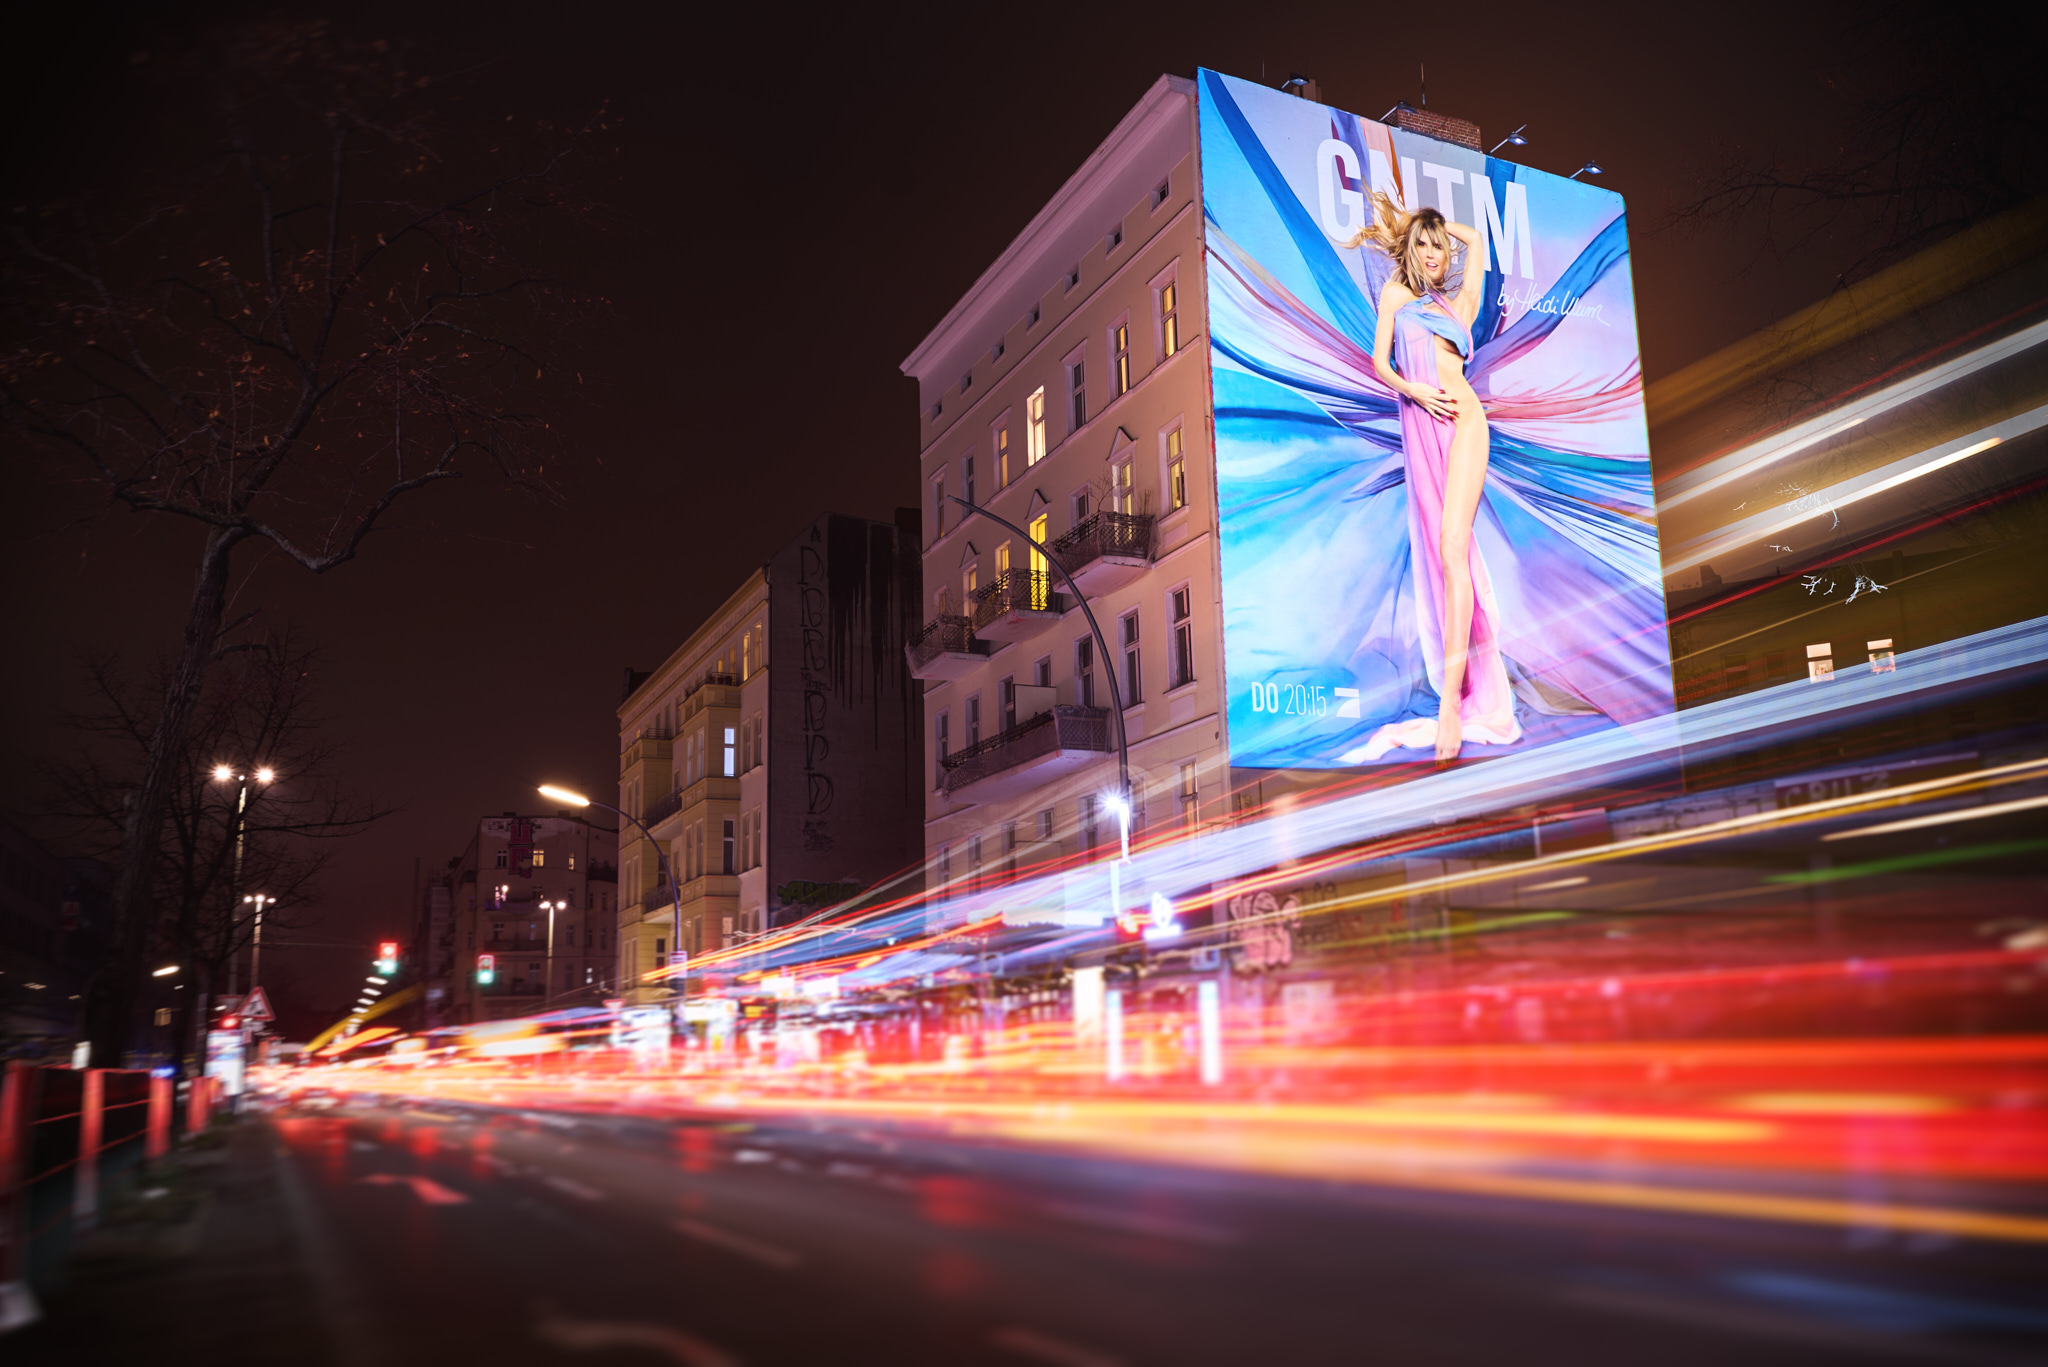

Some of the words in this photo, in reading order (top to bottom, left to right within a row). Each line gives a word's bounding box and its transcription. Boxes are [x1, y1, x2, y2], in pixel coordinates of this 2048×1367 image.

[1316, 138, 1535, 280] GNTM
[1496, 283, 1515, 317] by
[1514, 281, 1560, 315] Heidi
[1251, 681, 1279, 714] DO
[1284, 683, 1327, 717] 20:15
